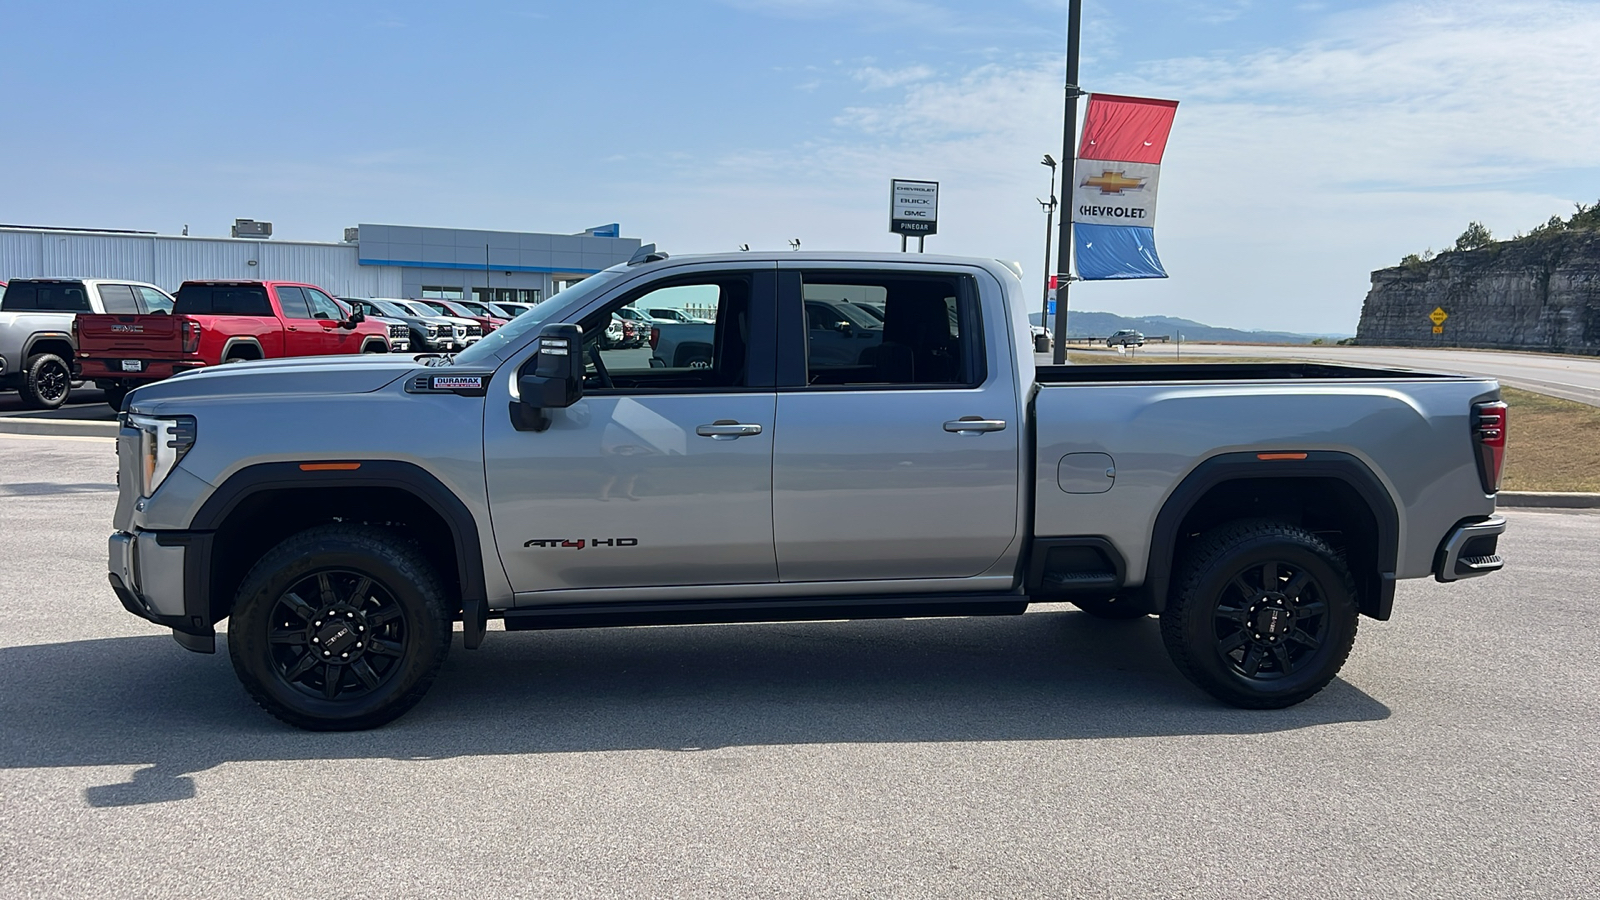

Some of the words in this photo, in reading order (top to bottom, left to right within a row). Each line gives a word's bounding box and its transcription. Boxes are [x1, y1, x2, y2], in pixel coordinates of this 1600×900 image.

[1079, 204, 1145, 219] CHEVROLET
[900, 222, 929, 231] PINEGAR
[111, 324, 144, 332] GMC
[523, 538, 586, 551] AT4
[591, 538, 638, 547] HD
